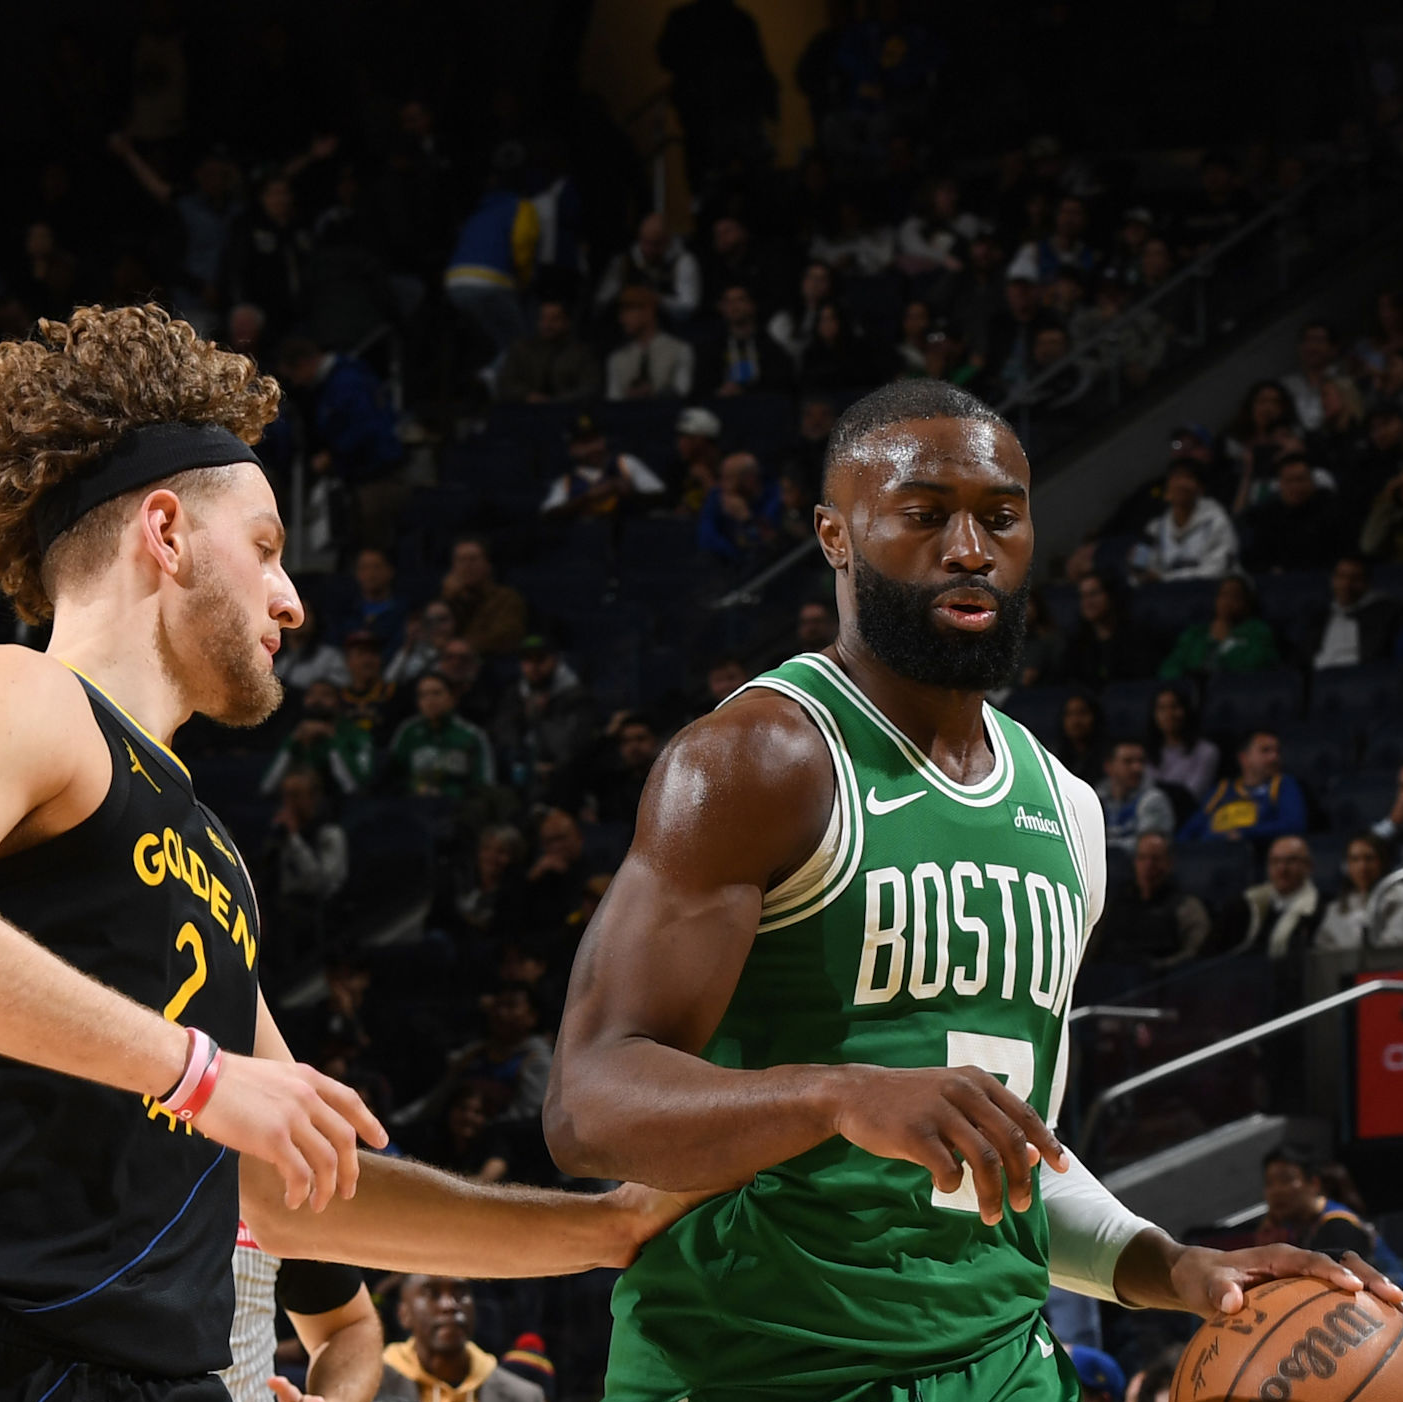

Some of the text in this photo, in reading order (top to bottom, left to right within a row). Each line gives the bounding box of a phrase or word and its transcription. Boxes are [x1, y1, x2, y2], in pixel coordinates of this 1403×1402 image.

[1014, 805, 1062, 837] Amica
[133, 826, 257, 972] GOLDEN
[853, 860, 1083, 1019] BOSTON
[163, 921, 208, 1024] 2
